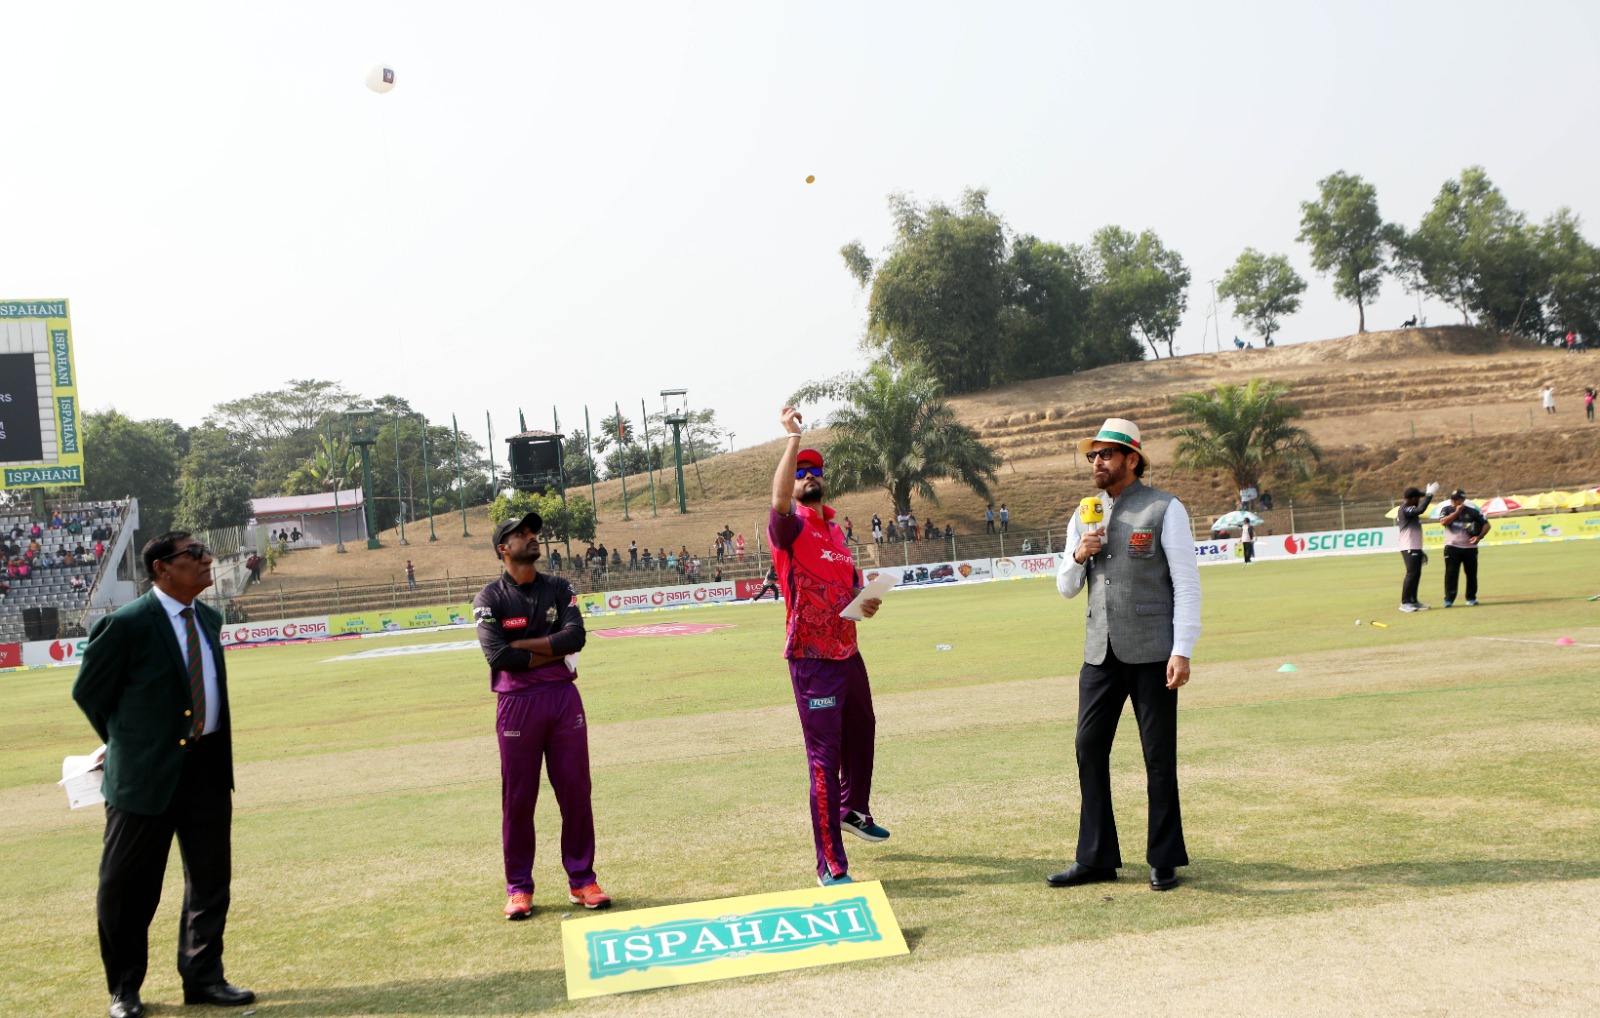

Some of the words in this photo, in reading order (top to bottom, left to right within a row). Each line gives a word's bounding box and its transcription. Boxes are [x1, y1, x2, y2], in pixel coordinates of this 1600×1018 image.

[55, 332, 69, 385] ISPAHANI
[61, 399, 75, 452] ISPAHANI
[8, 469, 78, 482] ISPAHANI
[1308, 531, 1384, 551] screen
[666, 590, 691, 602] নগদ
[708, 587, 733, 598] নগদ
[623, 594, 648, 605] নগদ
[251, 627, 278, 638] নগদ
[299, 622, 326, 634] নগদ
[601, 907, 866, 966] ISPAHANI
